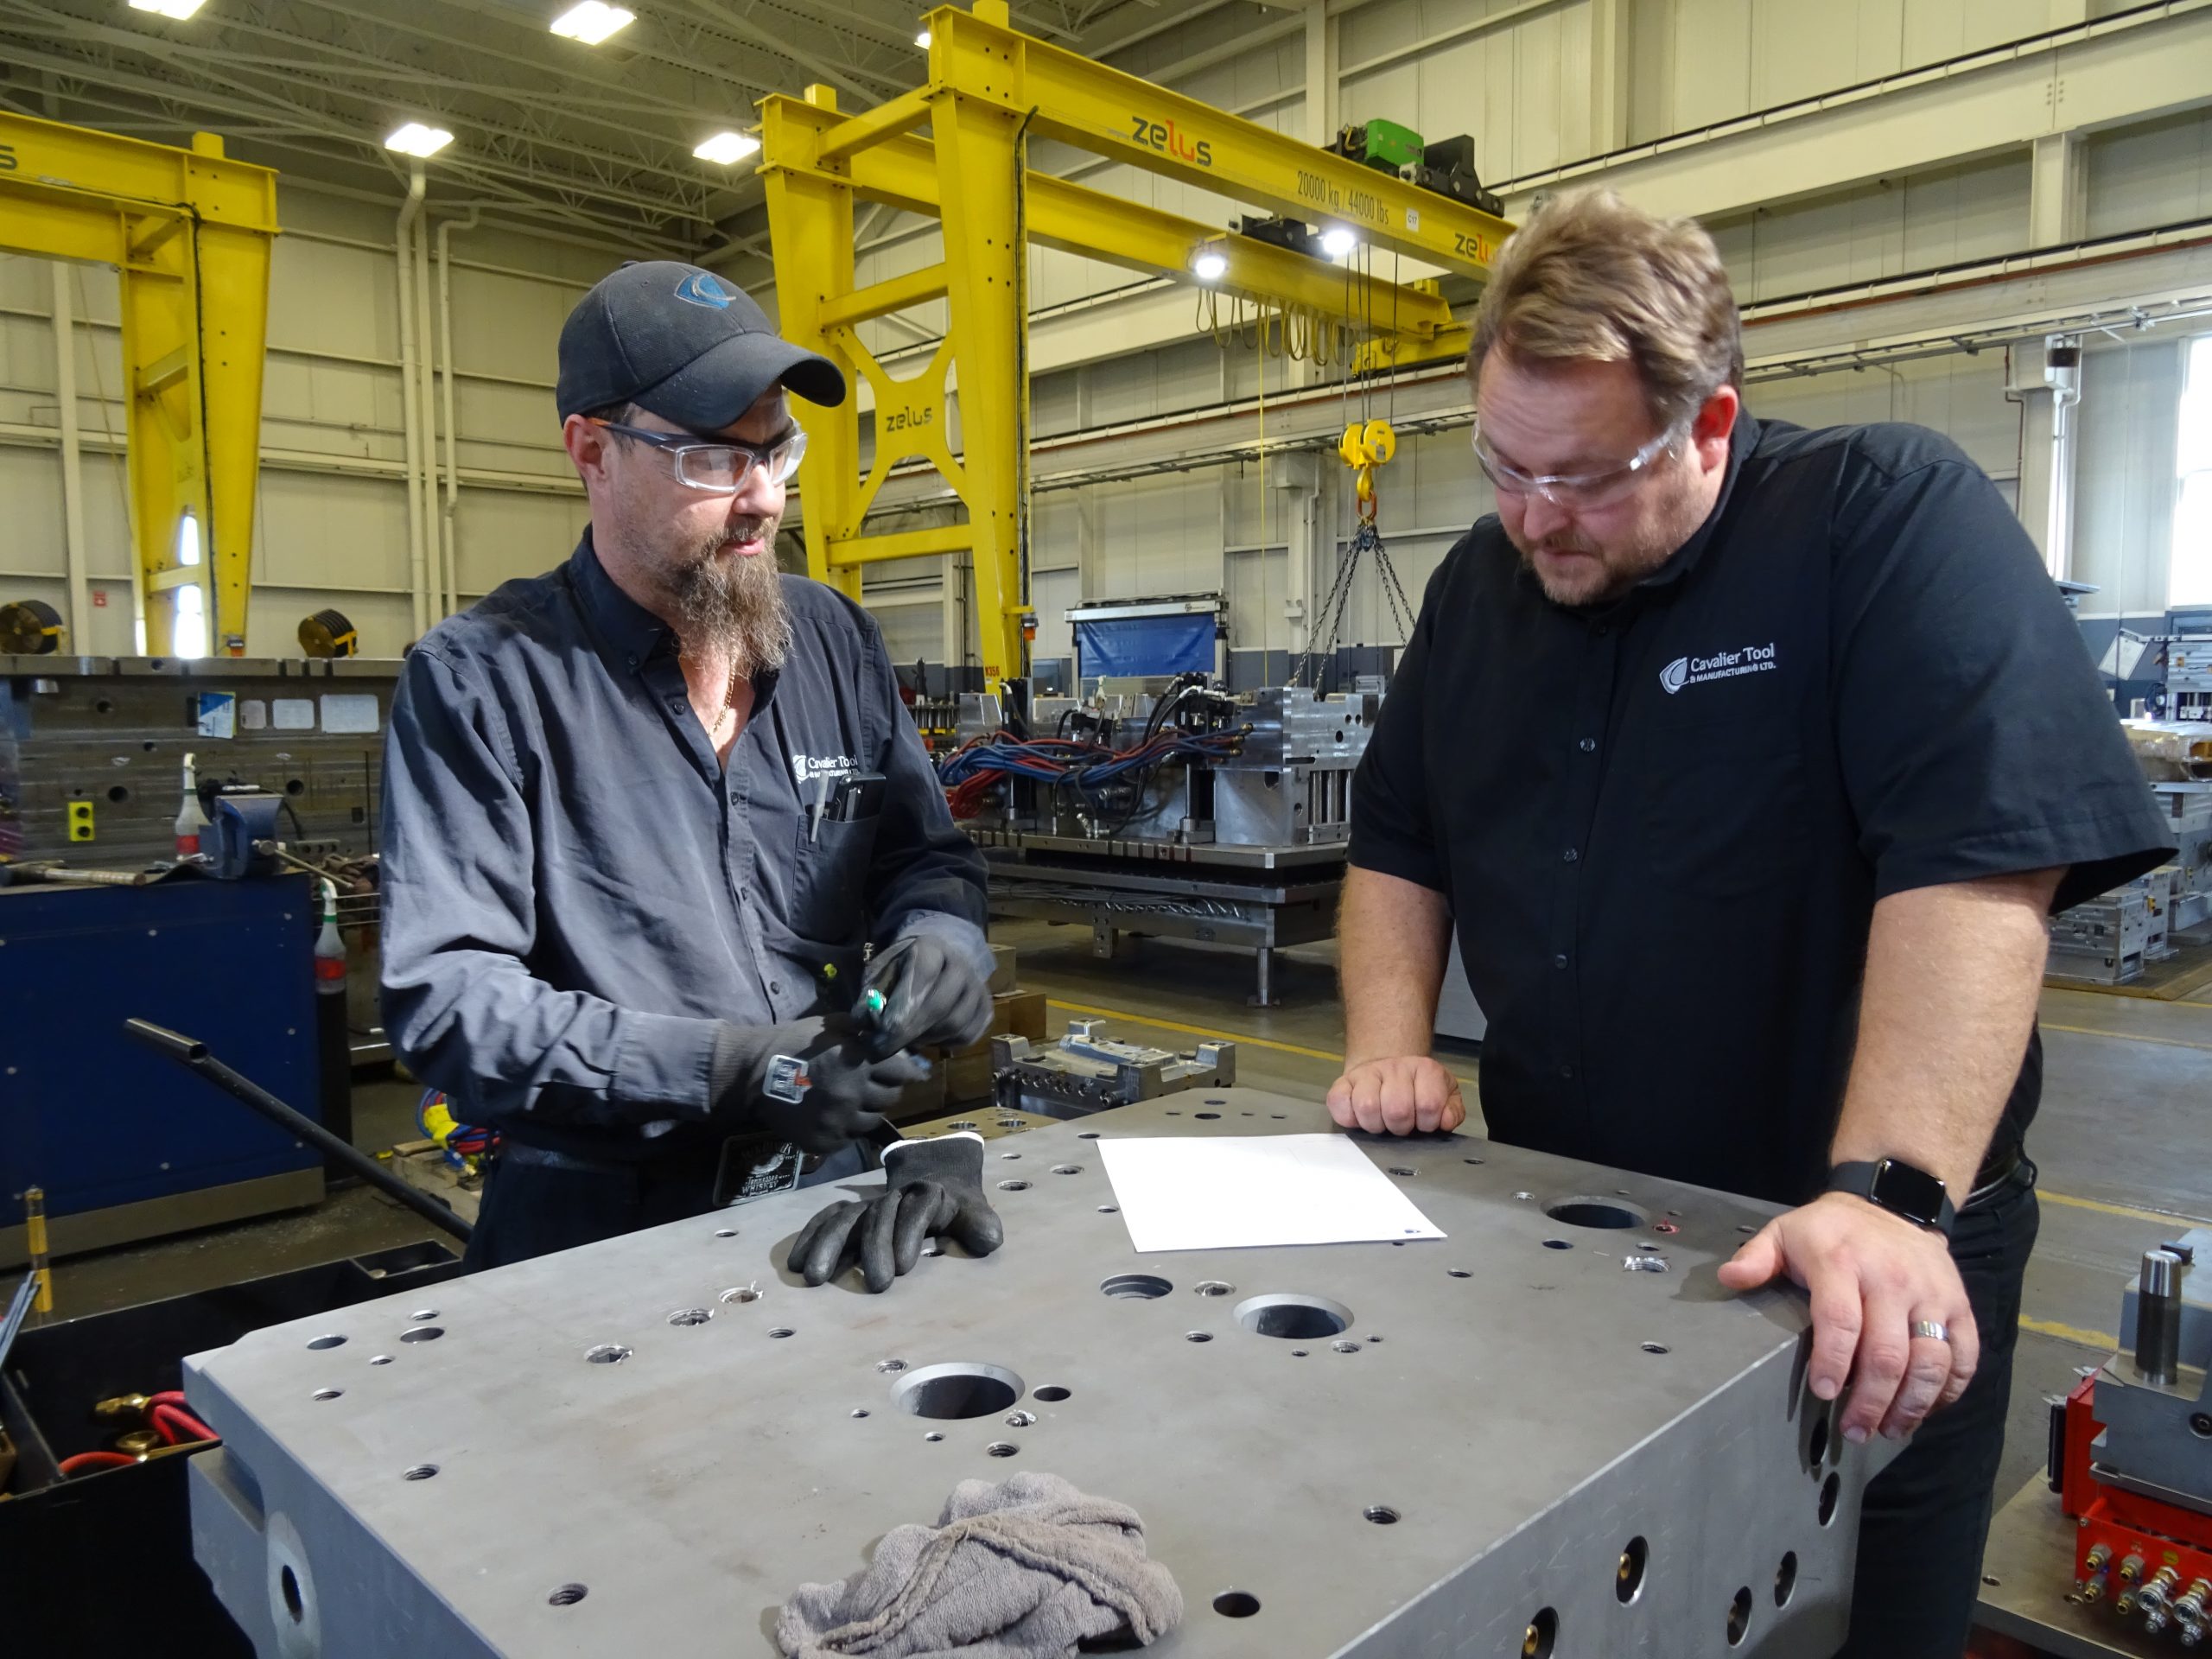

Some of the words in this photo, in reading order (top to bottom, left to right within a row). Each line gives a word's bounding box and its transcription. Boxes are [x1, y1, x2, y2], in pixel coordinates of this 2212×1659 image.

[1132, 116, 1212, 167] zelus
[1298, 171, 1326, 203] 20000
[1329, 181, 1339, 213] kg
[1348, 189, 1375, 220] 44000
[1376, 200, 1389, 226] lbs
[1408, 215, 1418, 225] C17
[1690, 652, 1741, 672] Cavalier
[1743, 642, 1775, 662] Tool
[1696, 664, 1758, 682] MANUFACTURING
[1759, 661, 1777, 671] LTD.
[808, 757, 837, 769] Cavalier
[838, 754, 858, 767] Tool
